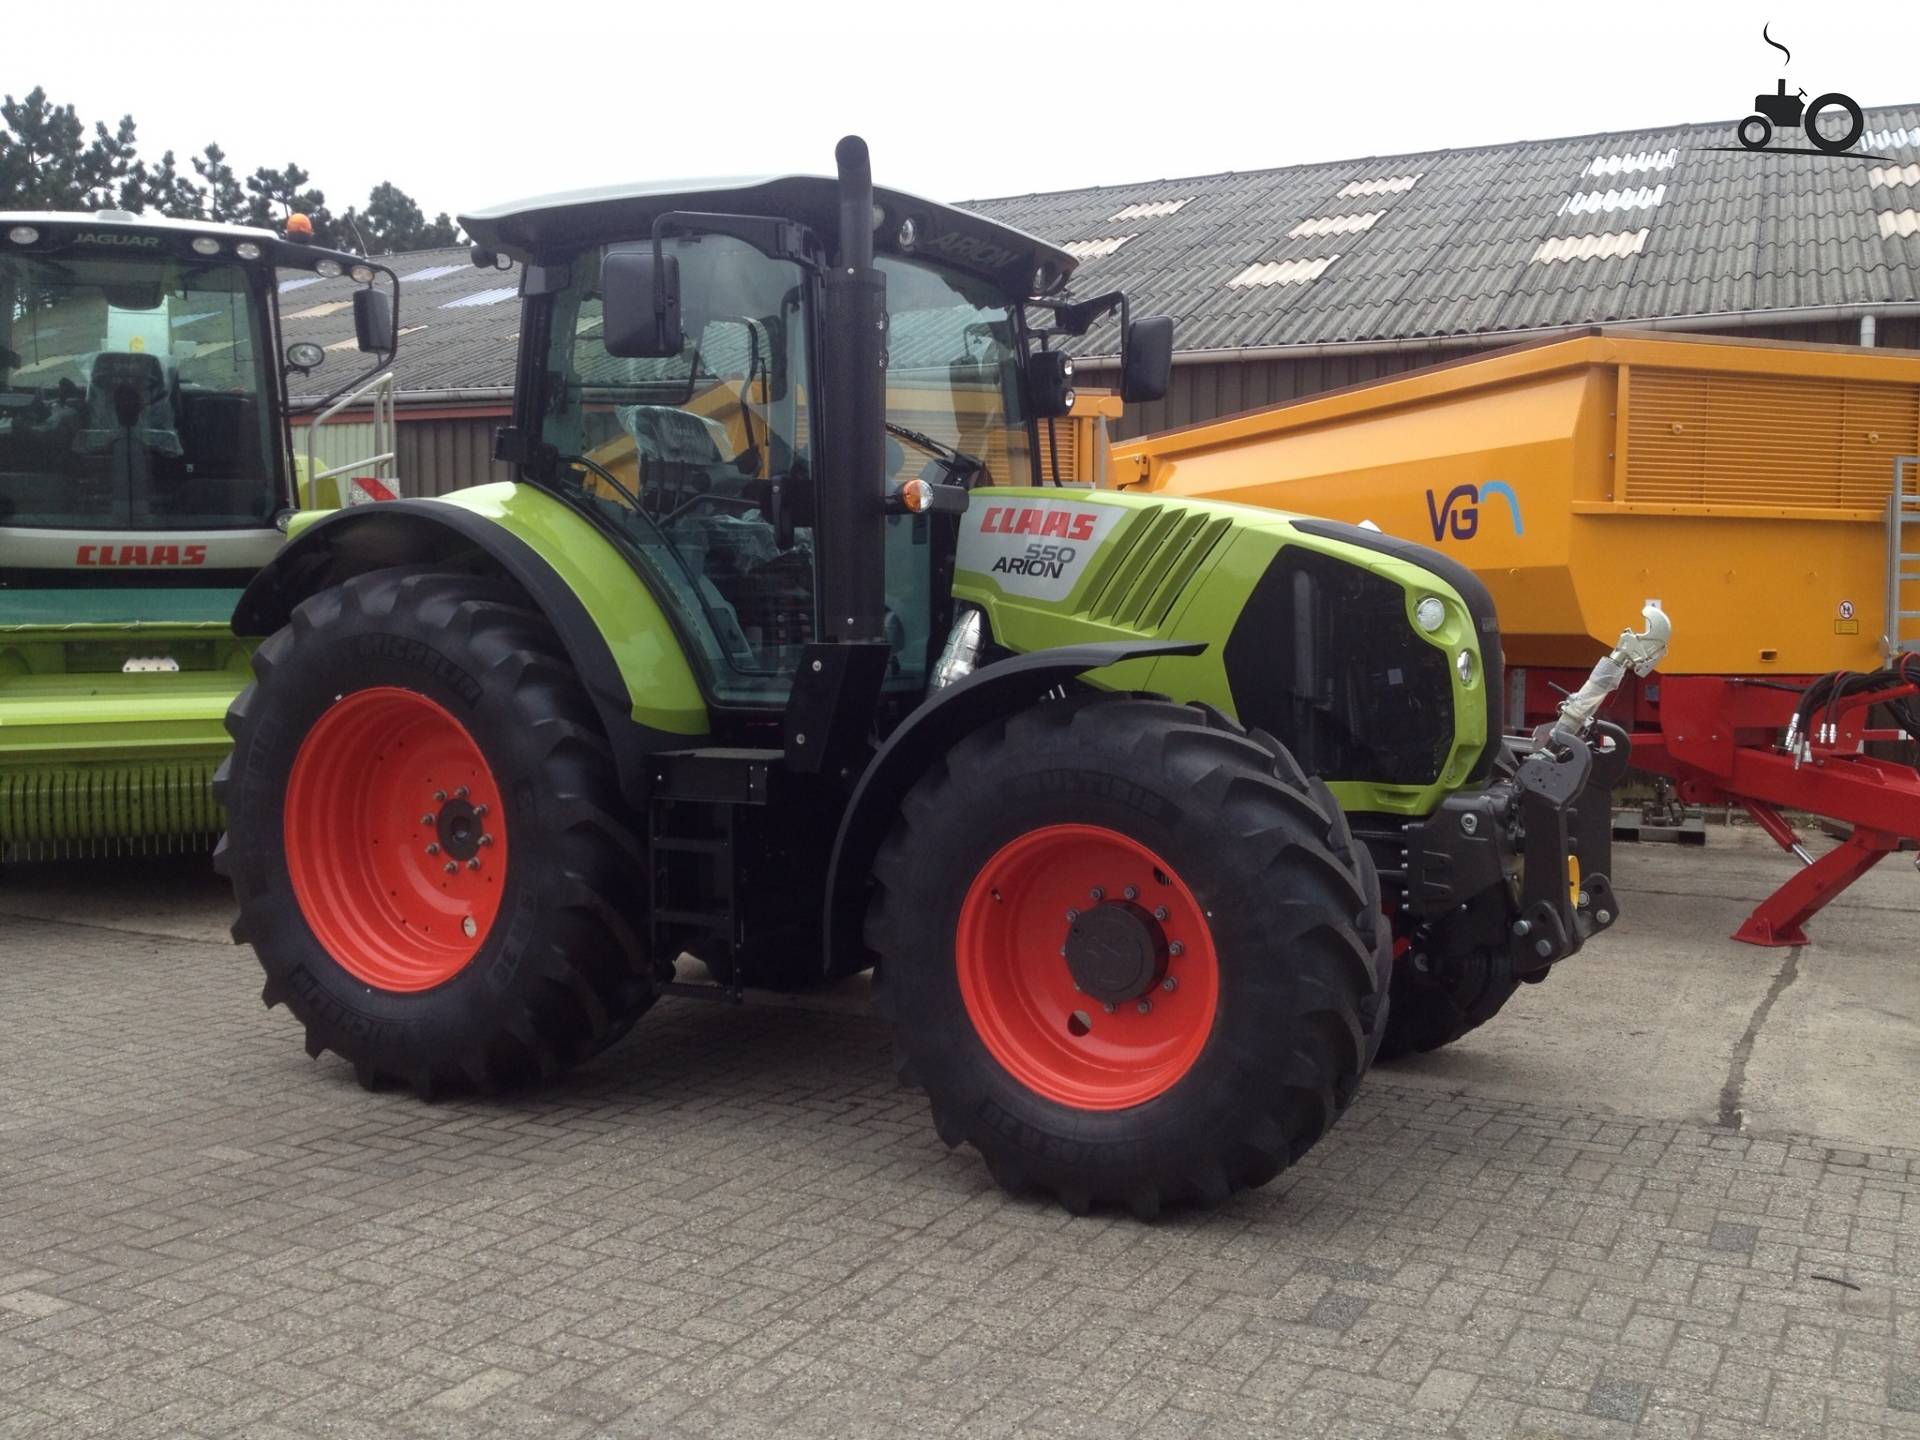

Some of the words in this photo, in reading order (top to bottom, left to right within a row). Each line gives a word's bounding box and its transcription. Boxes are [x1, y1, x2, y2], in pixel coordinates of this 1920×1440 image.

[73, 232, 160, 249] JAGUAR
[980, 507, 1098, 541] CLAAS
[76, 545, 208, 566] CLAAS
[1024, 543, 1076, 564] 550
[992, 557, 1064, 579] ARION
